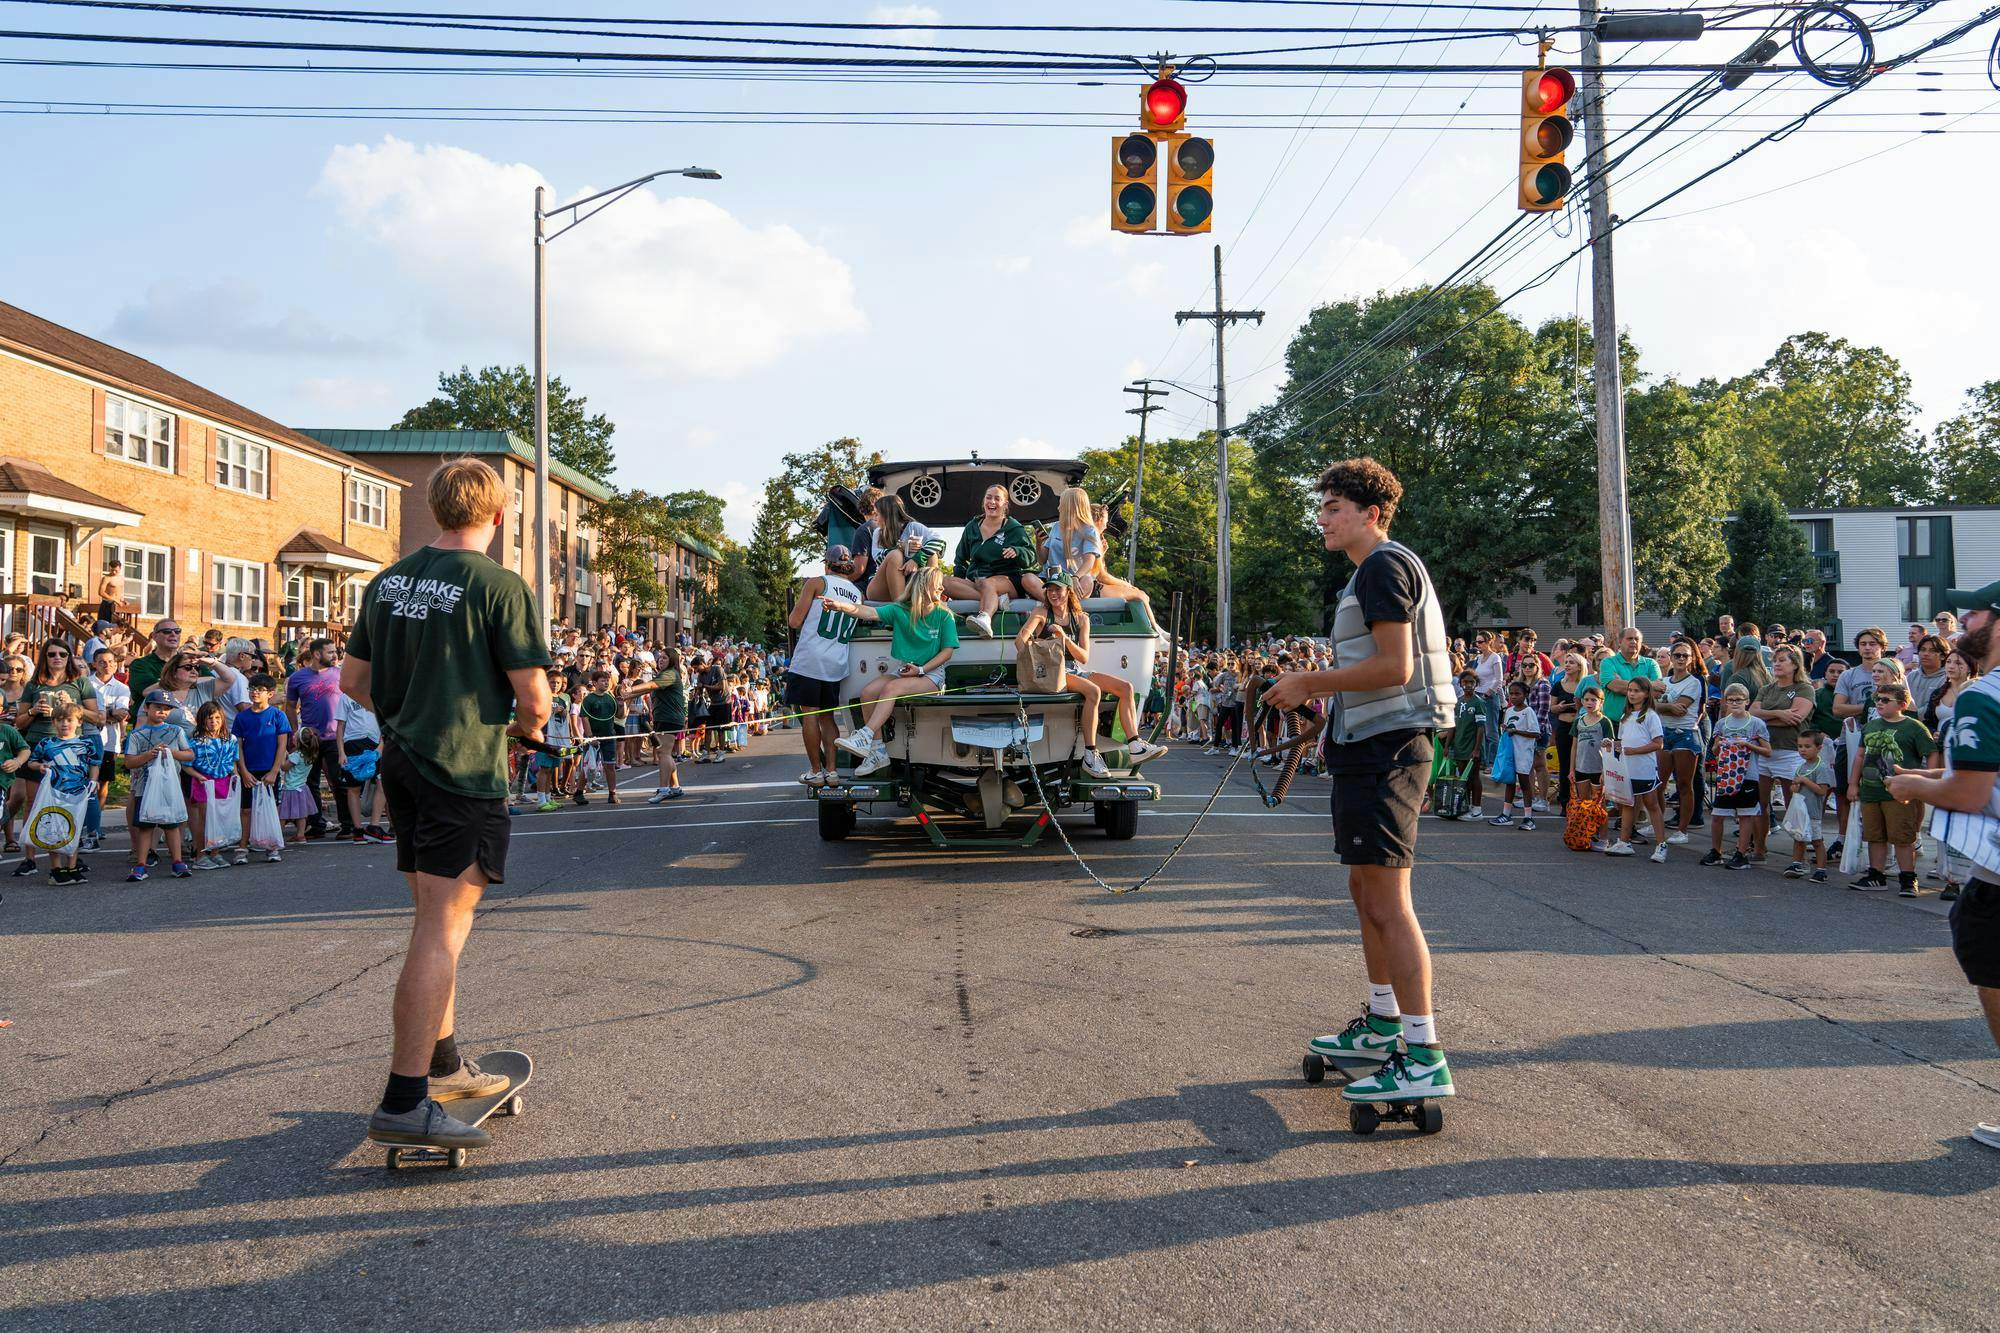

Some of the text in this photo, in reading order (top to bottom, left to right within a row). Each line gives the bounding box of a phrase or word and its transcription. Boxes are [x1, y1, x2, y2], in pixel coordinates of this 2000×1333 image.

[379, 575, 464, 602] MSU WAKE
[833, 586, 858, 603] YOUNG
[410, 591, 455, 613] RACE
